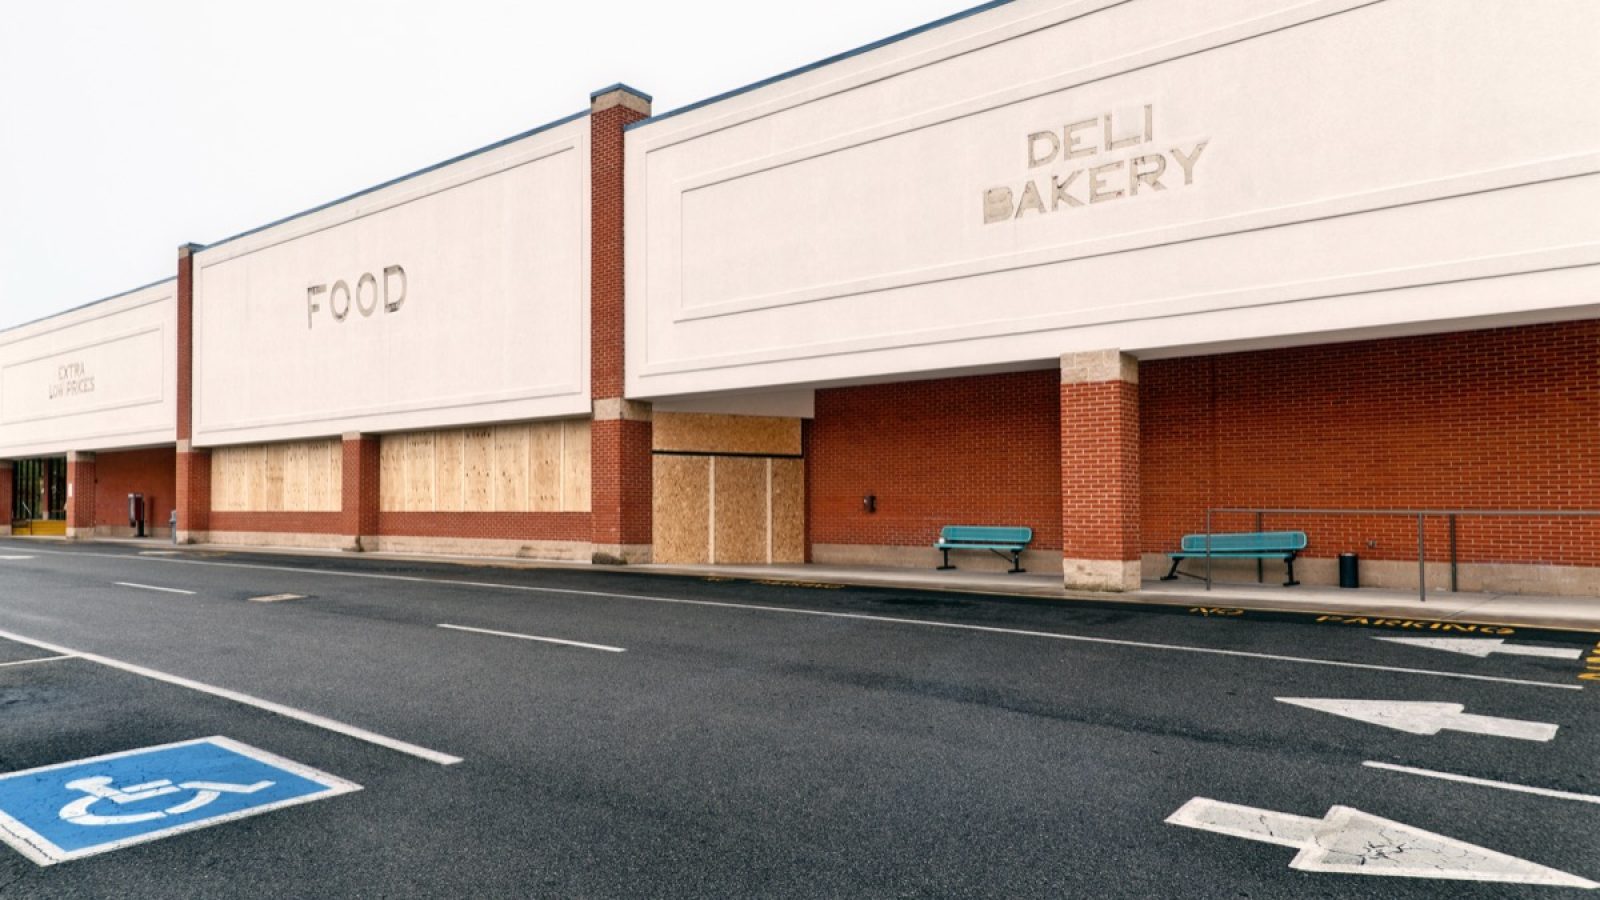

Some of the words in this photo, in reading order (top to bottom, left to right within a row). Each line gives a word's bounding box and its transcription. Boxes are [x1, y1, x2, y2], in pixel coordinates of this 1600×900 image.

[1027, 103, 1153, 169] DELI
[982, 136, 1211, 225] BAKERY
[307, 264, 408, 329] FOOD
[48, 383, 64, 400] LOW
[66, 376, 96, 397] PRICES
[58, 361, 85, 380] EXTRA
[1315, 614, 1516, 636] PARKING
